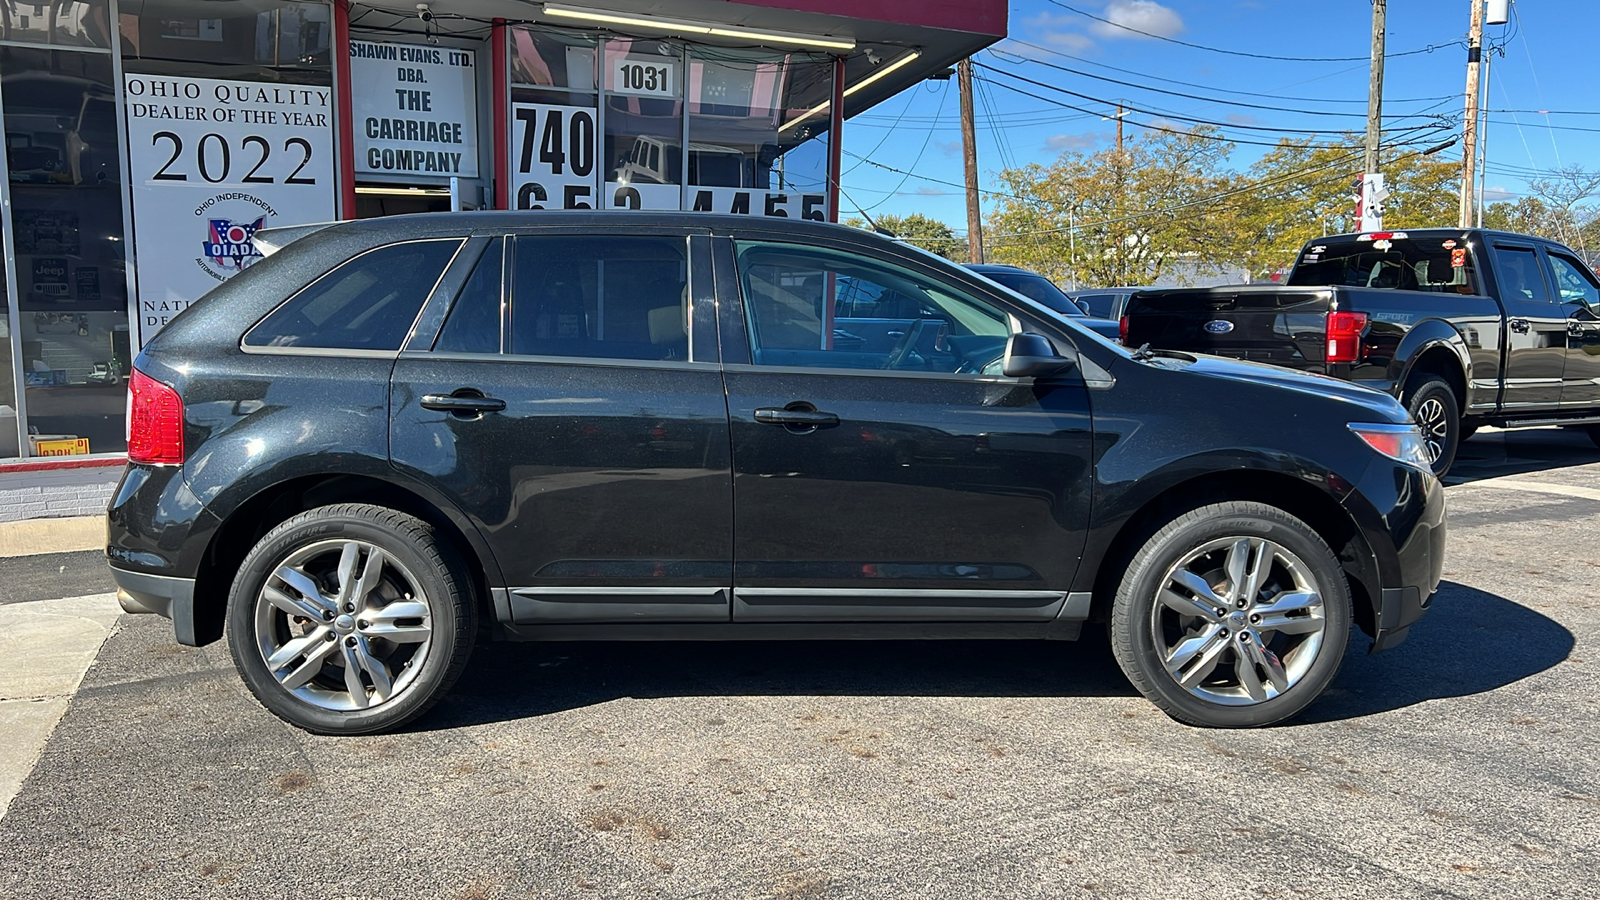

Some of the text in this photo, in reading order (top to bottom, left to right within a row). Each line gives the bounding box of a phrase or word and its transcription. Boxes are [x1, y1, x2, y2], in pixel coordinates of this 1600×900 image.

[350, 42, 473, 67] SHAWN EVANS. LTD.
[397, 67, 428, 83] DBA.
[620, 64, 667, 91] 1031
[128, 79, 329, 106] OHIO QUALITY
[395, 88, 432, 112] THE
[132, 103, 328, 127] DEALER OF THE YEAR
[365, 117, 463, 144] CARRIAGE
[516, 107, 594, 177] 740
[152, 131, 316, 185] 2022
[367, 147, 462, 173] COMPANY
[194, 192, 279, 217] OHIO INDEPENDENT
[211, 244, 261, 256] OIADA
[35, 265, 65, 277] Jeep
[195, 257, 227, 282] AUTOMOBILE
[143, 300, 190, 312] NATI
[1372, 312, 1414, 321] SPORT
[273, 524, 328, 553] STARFIRE
